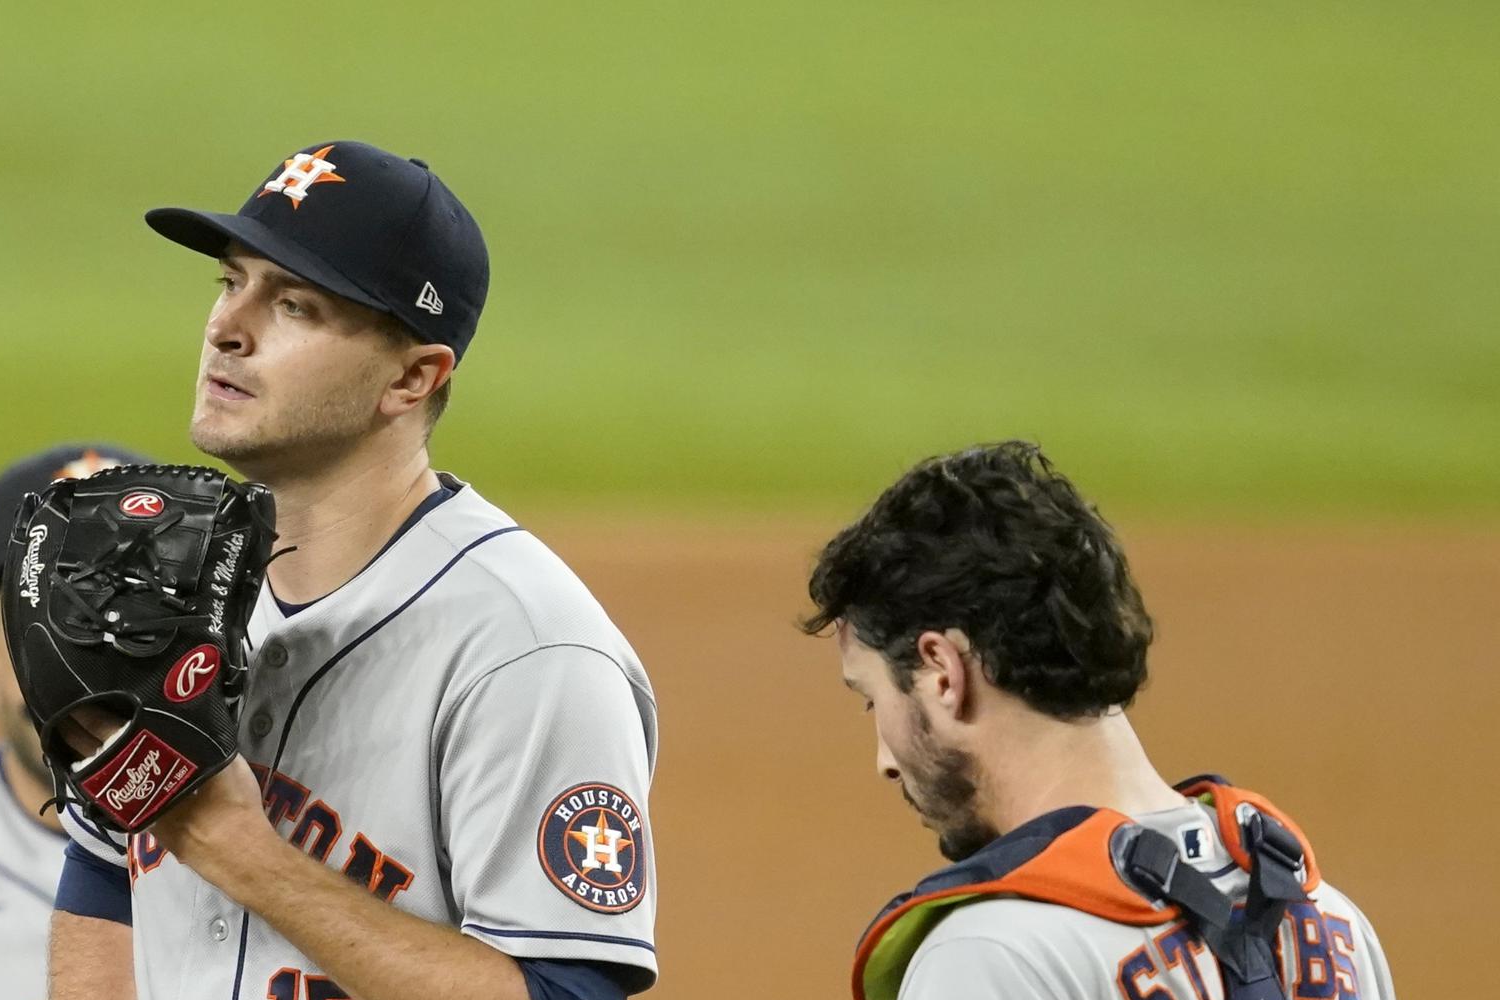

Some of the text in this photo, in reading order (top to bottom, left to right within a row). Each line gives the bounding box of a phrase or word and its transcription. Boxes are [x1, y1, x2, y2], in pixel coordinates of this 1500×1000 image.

[264, 152, 337, 202] H
[20, 524, 48, 608] Rawlings
[211, 583, 228, 597] &
[176, 651, 215, 697] R
[106, 750, 161, 810] Rawlings
[554, 789, 641, 832] HOUSTON
[581, 825, 622, 873] H
[562, 872, 638, 906] ASTROS
